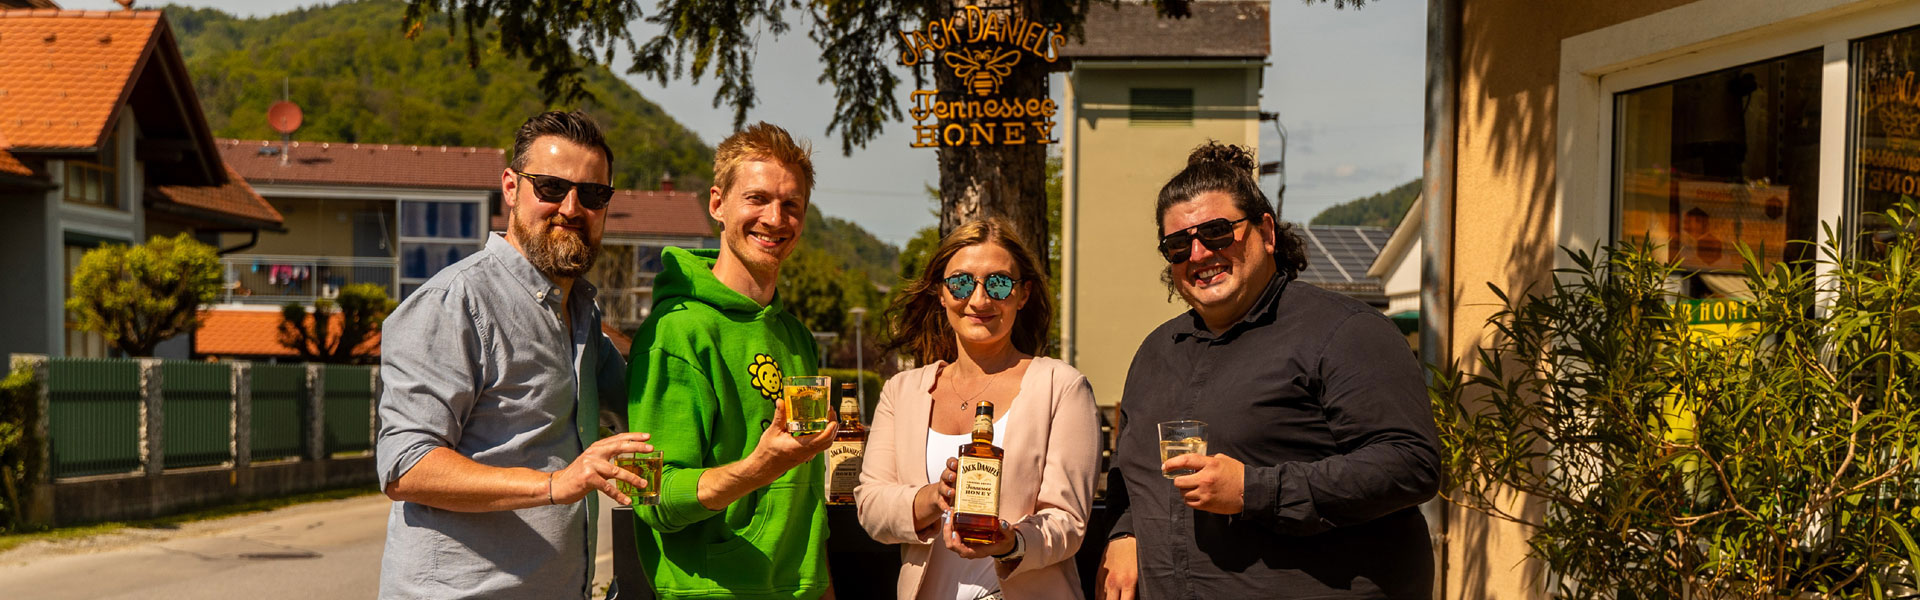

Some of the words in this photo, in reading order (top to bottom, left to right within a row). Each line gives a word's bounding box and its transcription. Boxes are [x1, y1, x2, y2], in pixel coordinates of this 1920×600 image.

[899, 18, 961, 66] JACK
[964, 5, 1066, 63] DANIEL'S
[910, 89, 1056, 121] Tennessee
[912, 121, 1056, 148] HONEY
[1700, 300, 1759, 321] HONI
[831, 449, 842, 457] JACK
[962, 463, 977, 475] JACK
[977, 462, 999, 477] DANIEL'S
